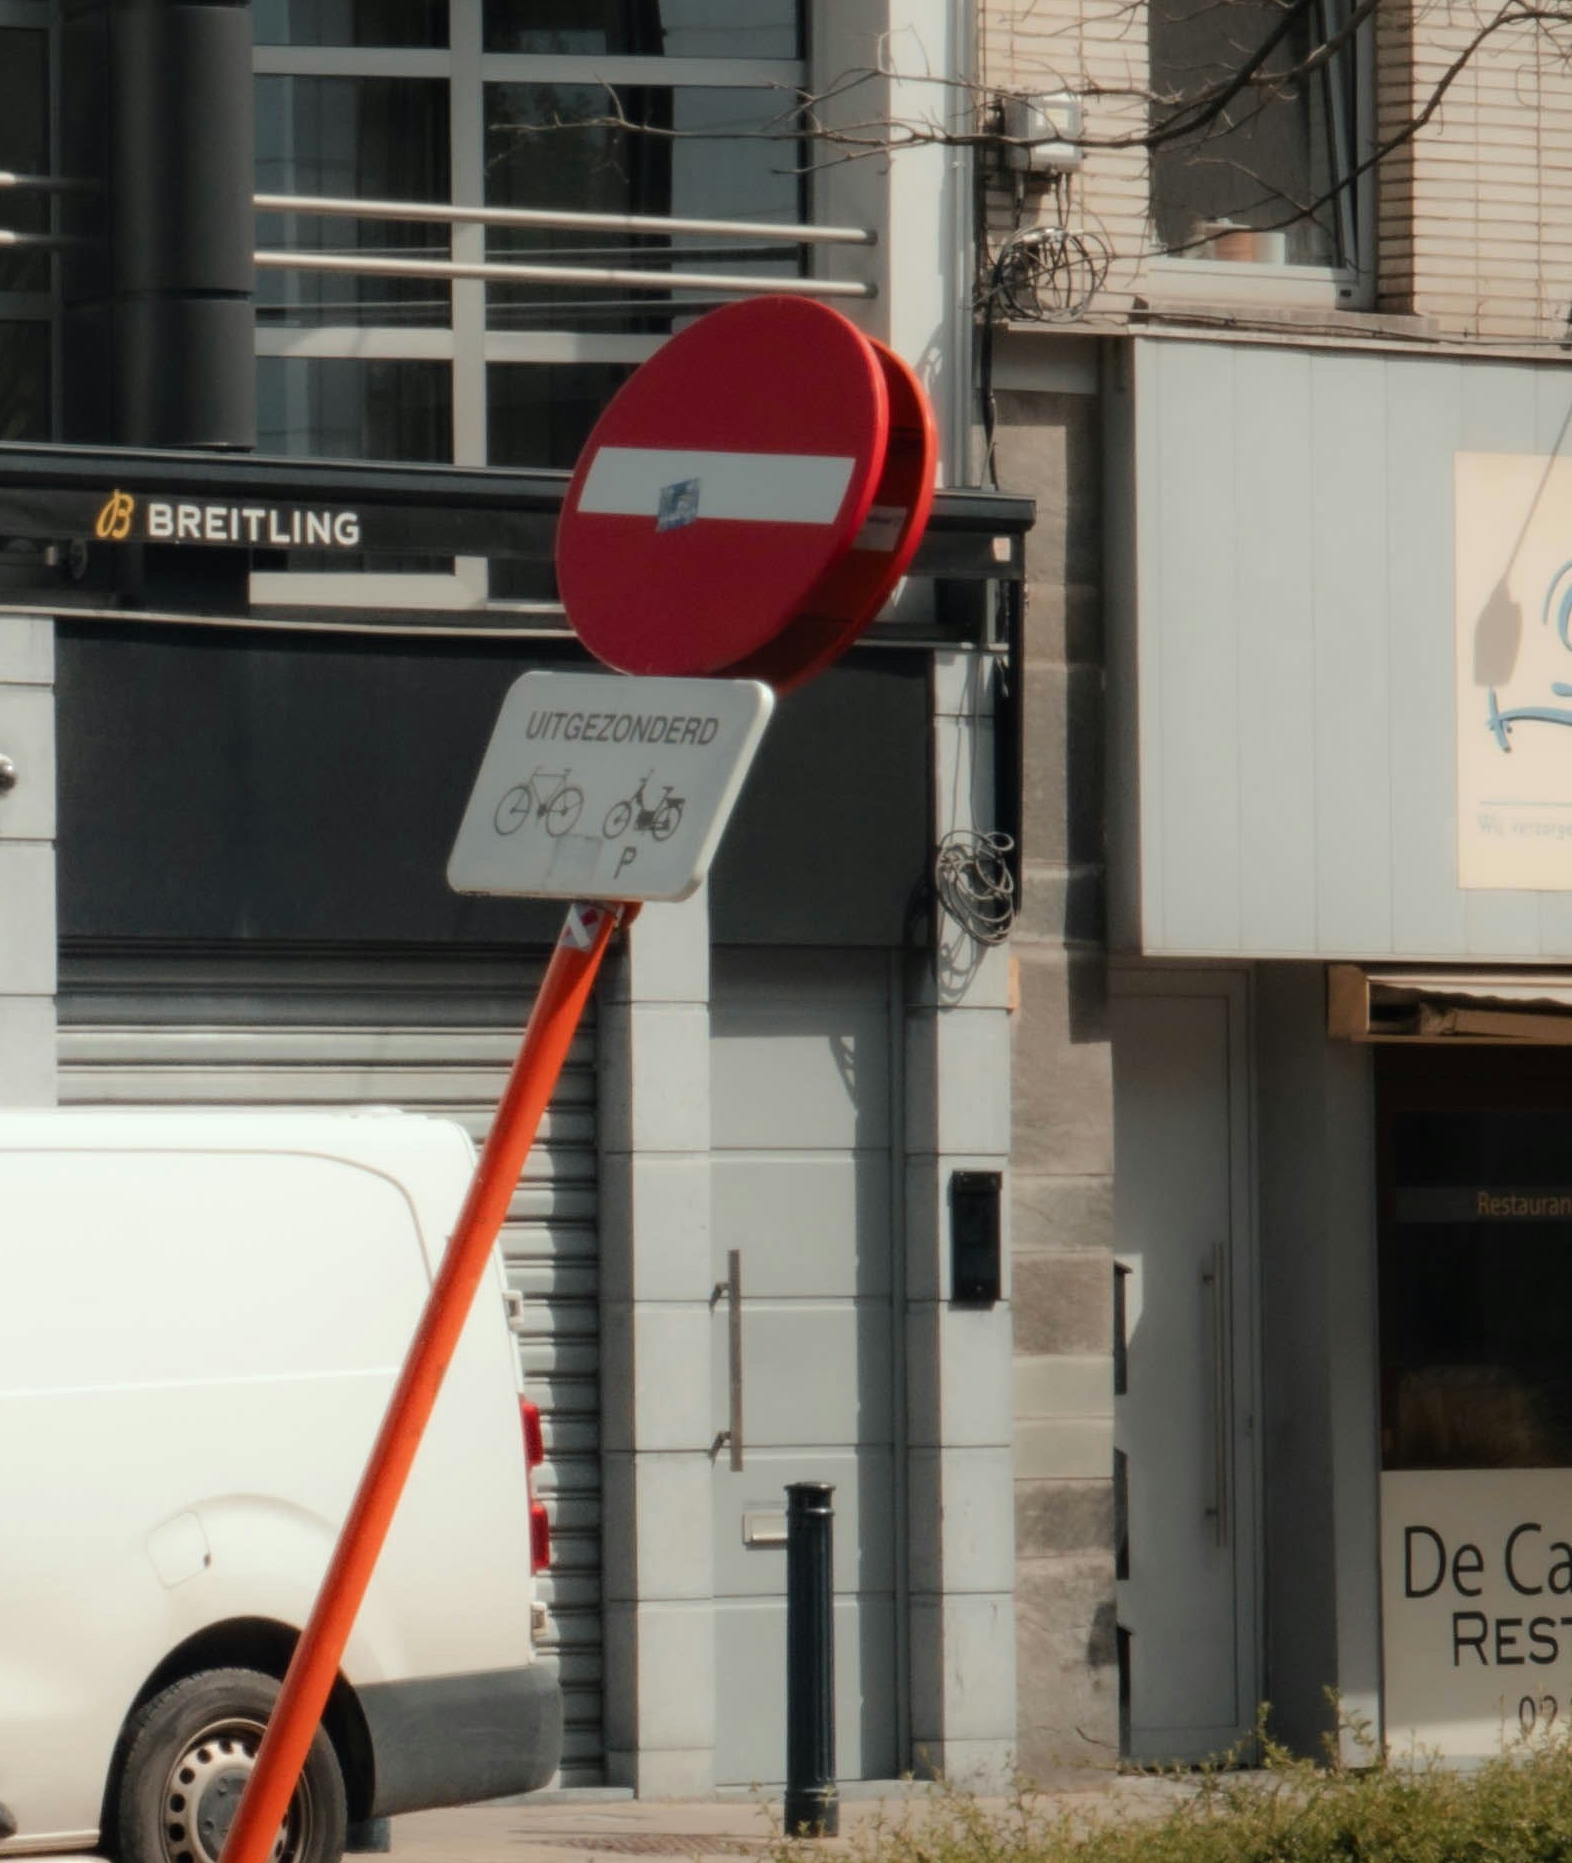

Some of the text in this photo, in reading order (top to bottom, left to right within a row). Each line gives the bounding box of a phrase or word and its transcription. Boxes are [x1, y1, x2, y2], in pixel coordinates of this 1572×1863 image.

[148, 503, 360, 545] BREITLING
[526, 711, 719, 745] UITGEZONDERD
[614, 846, 637, 880] P
[1404, 1522, 1572, 1598] De Ca
